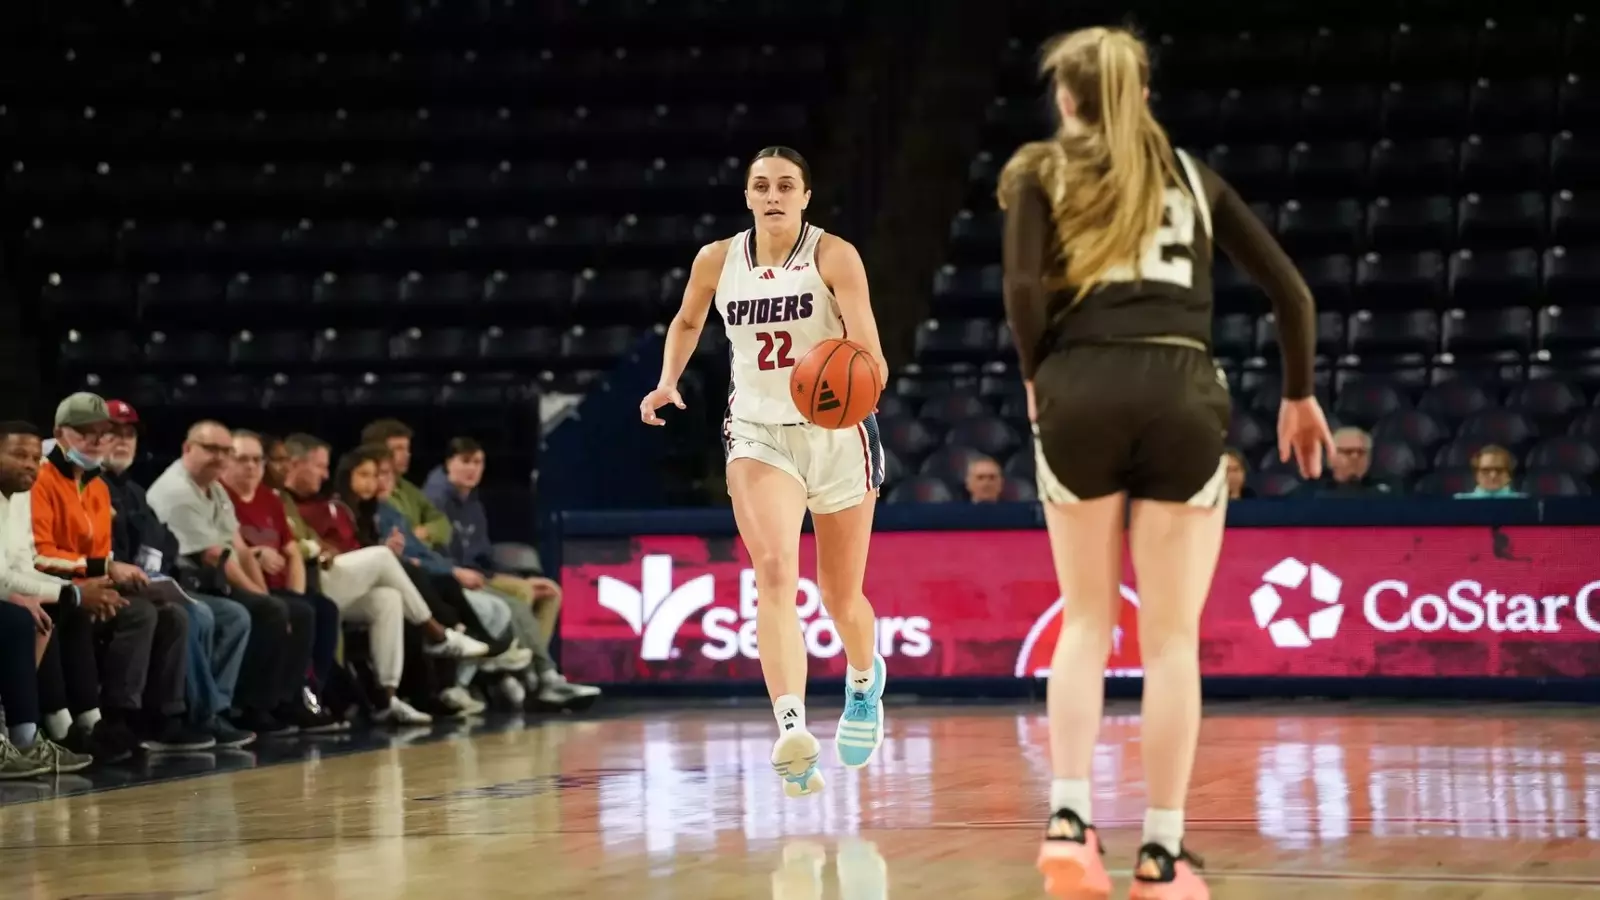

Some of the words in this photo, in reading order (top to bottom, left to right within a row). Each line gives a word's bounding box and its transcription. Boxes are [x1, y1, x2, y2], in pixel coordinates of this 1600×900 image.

[726, 292, 814, 326] SPIDERS
[755, 330, 795, 371] 22
[1363, 579, 1570, 633] CoStar
